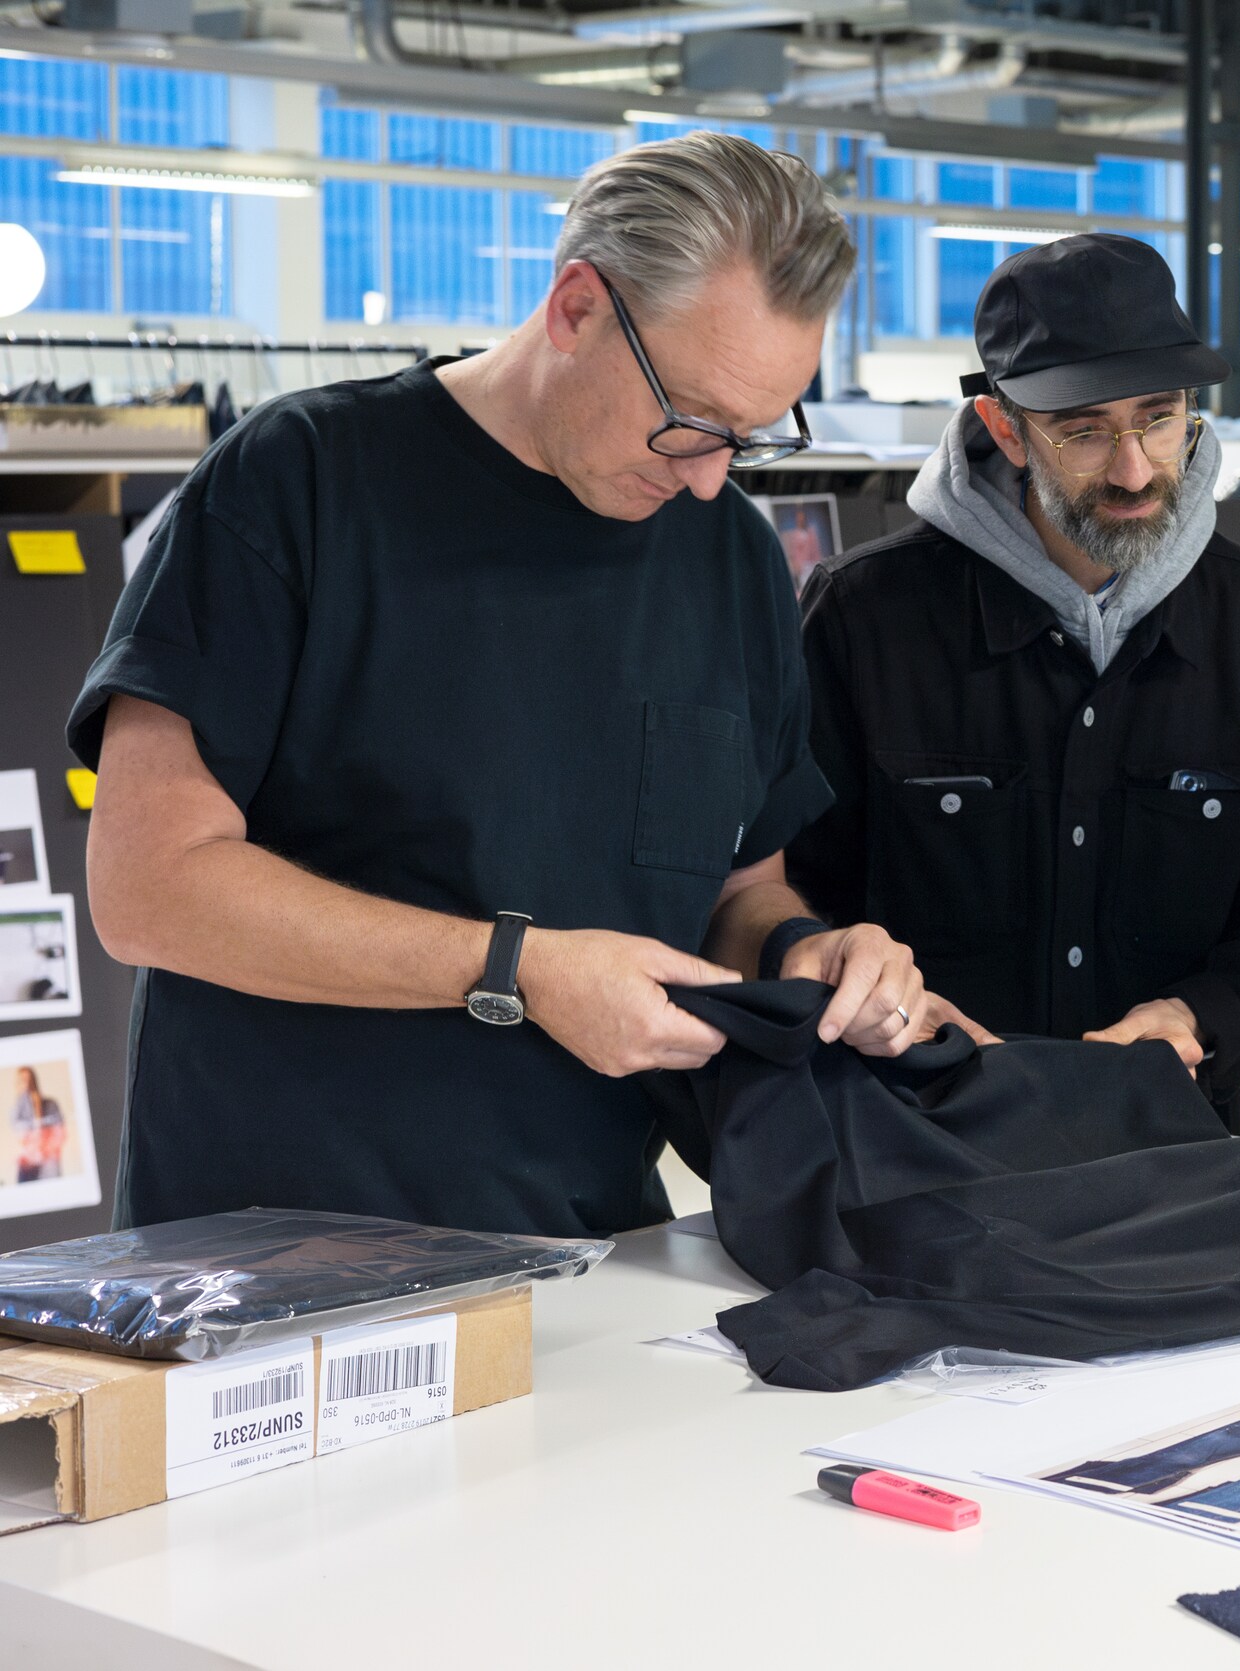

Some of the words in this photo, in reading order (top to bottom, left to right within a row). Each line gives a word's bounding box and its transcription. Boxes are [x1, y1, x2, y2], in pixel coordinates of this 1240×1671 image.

[427, 1385, 447, 1398] 0516
[322, 1406, 339, 1418] 350
[354, 1407, 411, 1427] NL-DPD-0516
[213, 1411, 304, 1450] SUNP/23312
